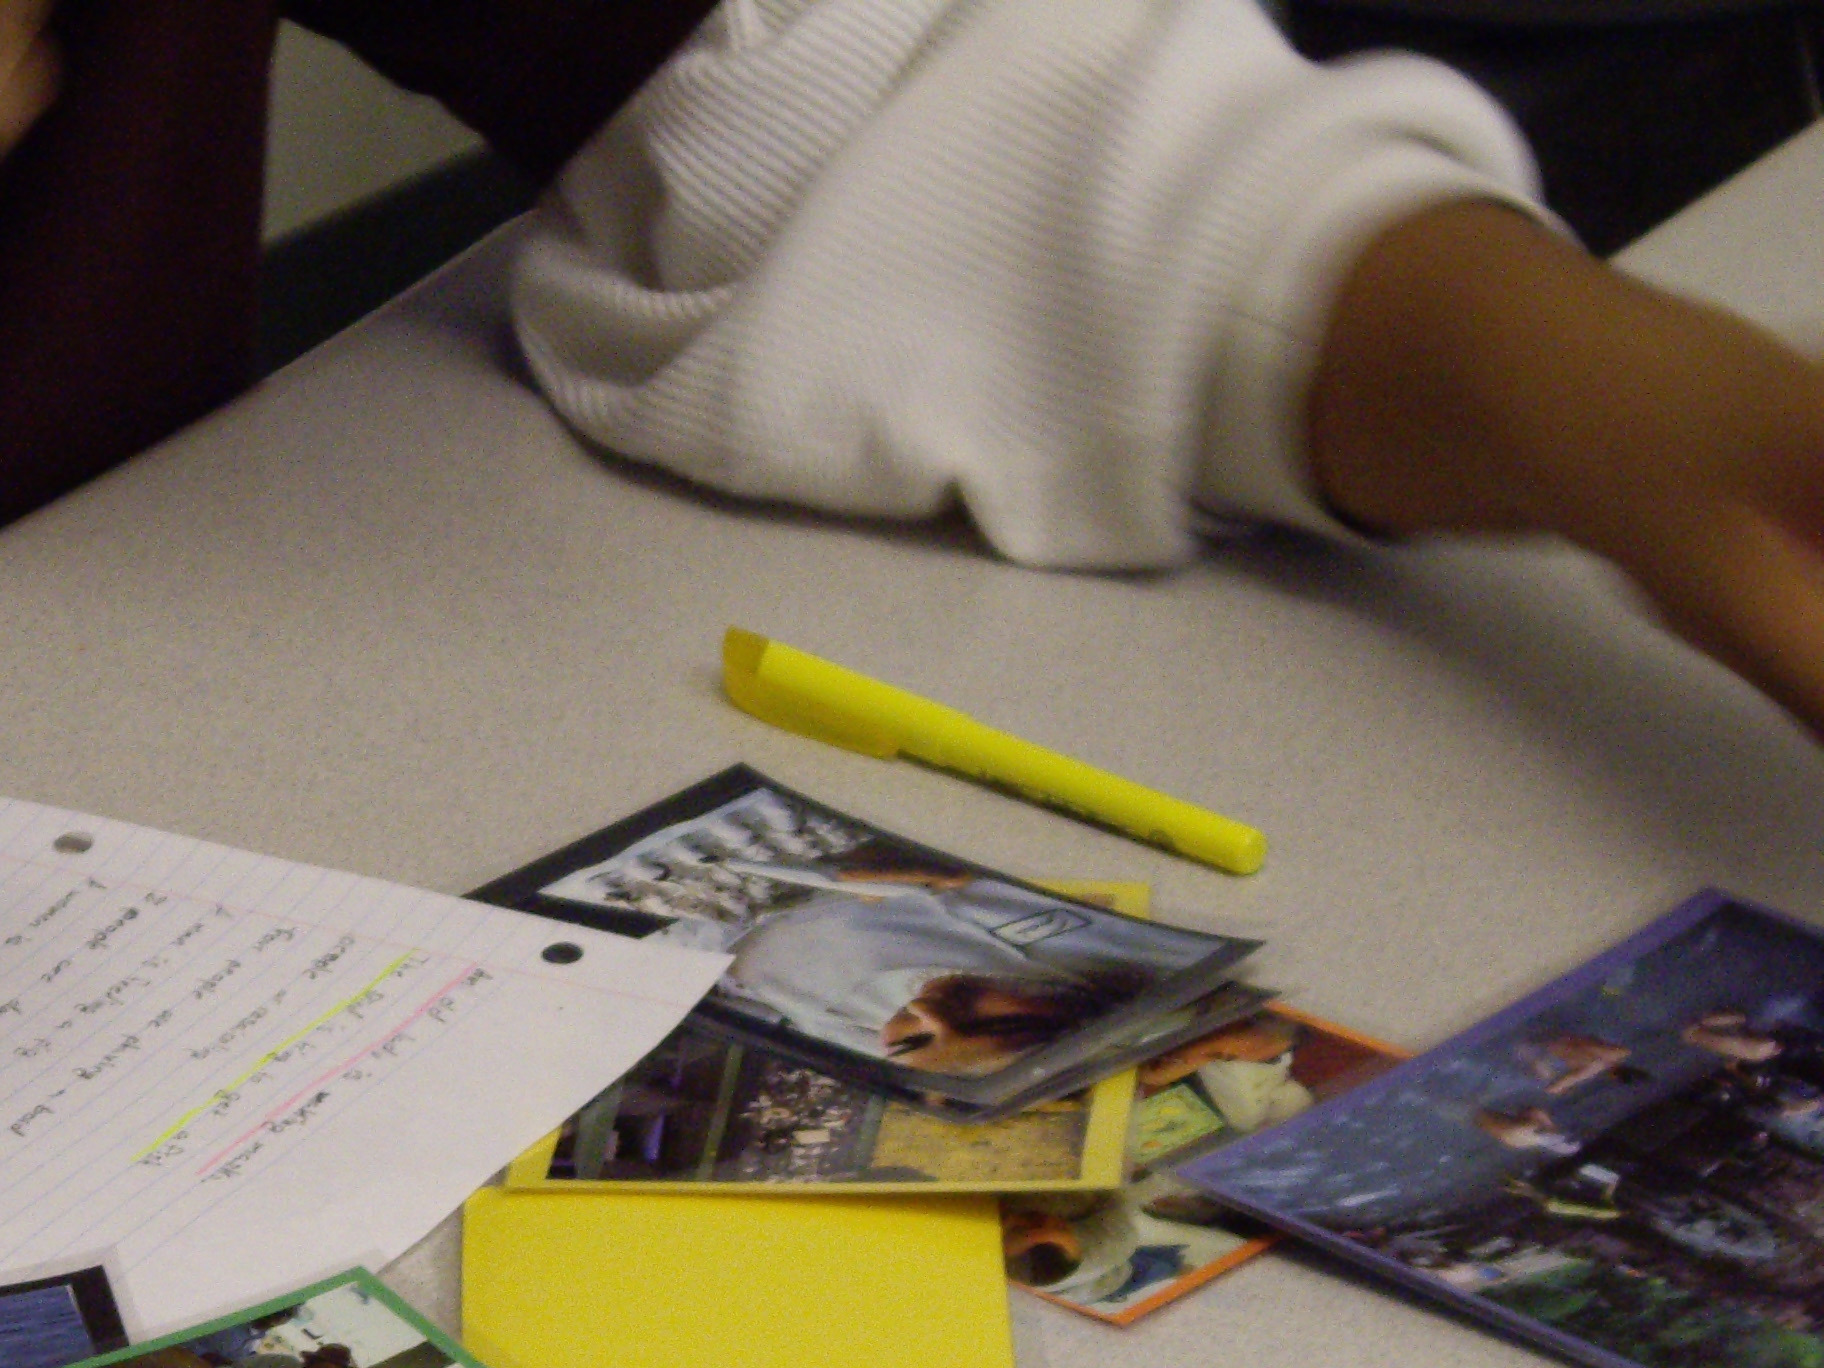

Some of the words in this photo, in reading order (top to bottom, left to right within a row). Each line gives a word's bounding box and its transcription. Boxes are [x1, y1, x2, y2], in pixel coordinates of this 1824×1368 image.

[192, 959, 242, 1000] people
[429, 998, 455, 1024] old
[211, 1089, 241, 1116] get
